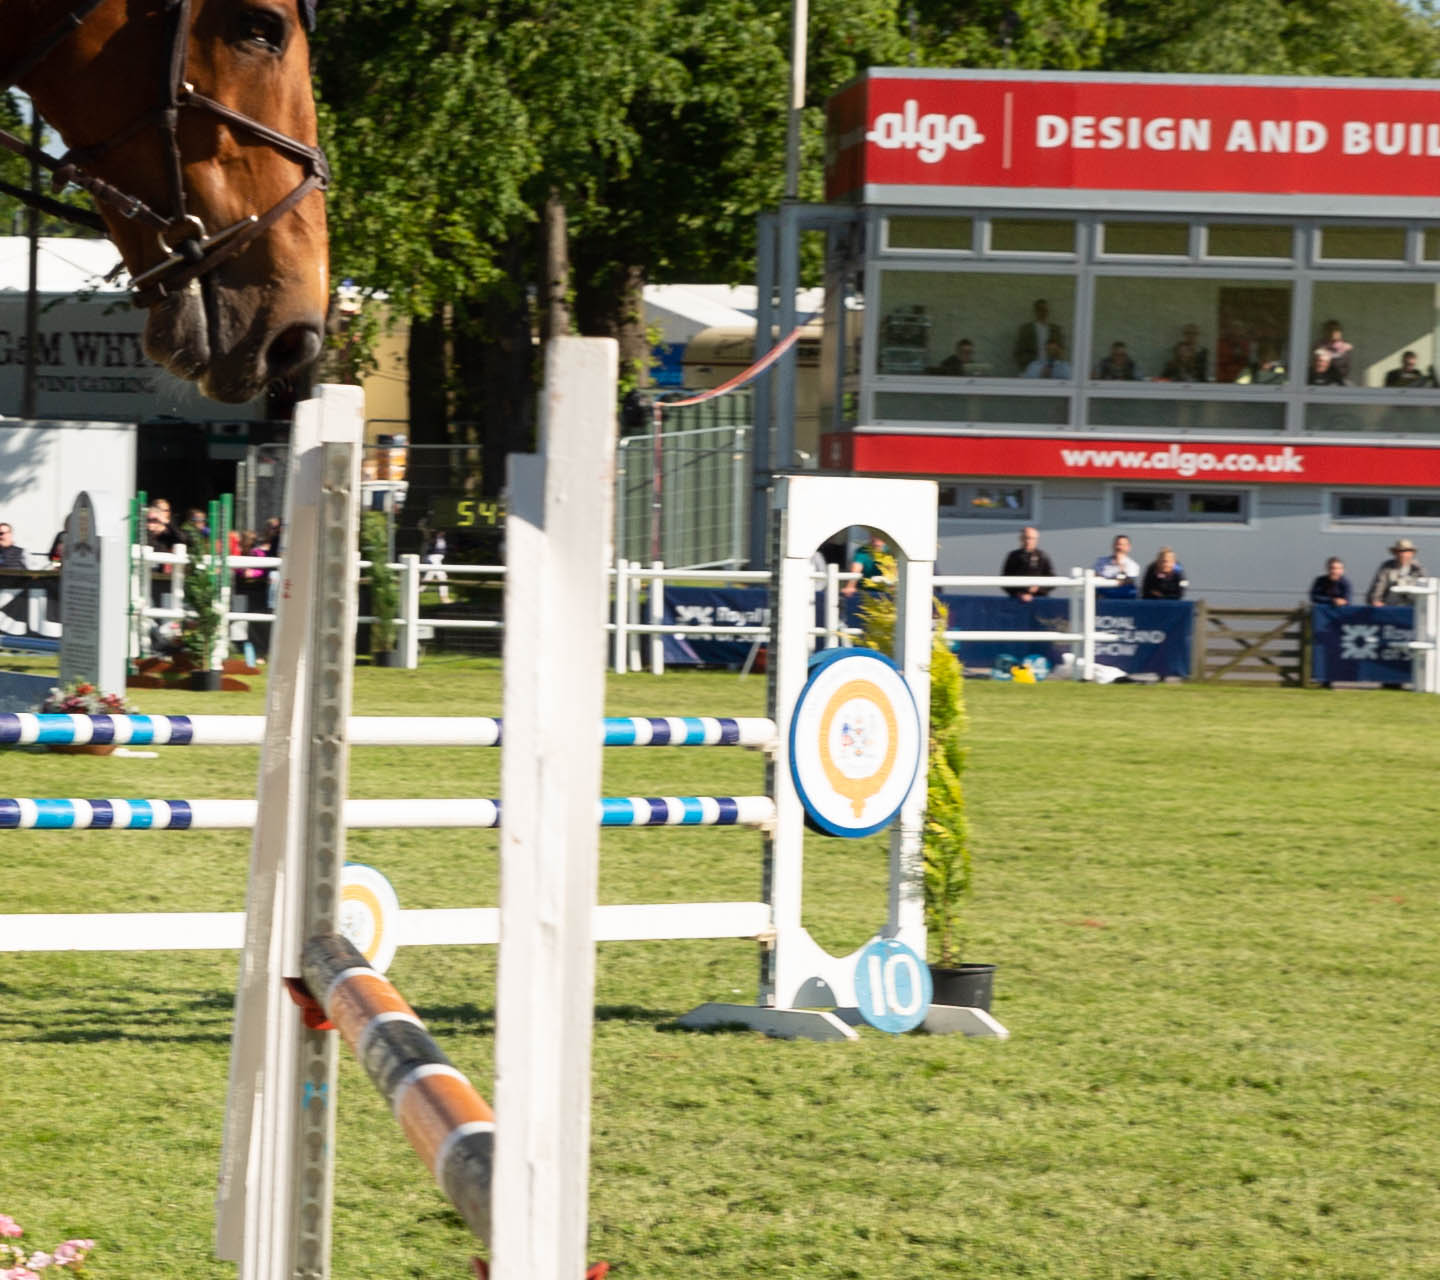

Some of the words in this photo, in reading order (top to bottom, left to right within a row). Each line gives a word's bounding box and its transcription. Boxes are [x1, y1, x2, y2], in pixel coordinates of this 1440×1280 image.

[866, 99, 985, 163] algo
[1036, 115, 1211, 151] DESIGN
[1225, 119, 1328, 153] AND
[1060, 443, 1304, 476] www.algo.co.uk
[867, 954, 922, 1016] 10
